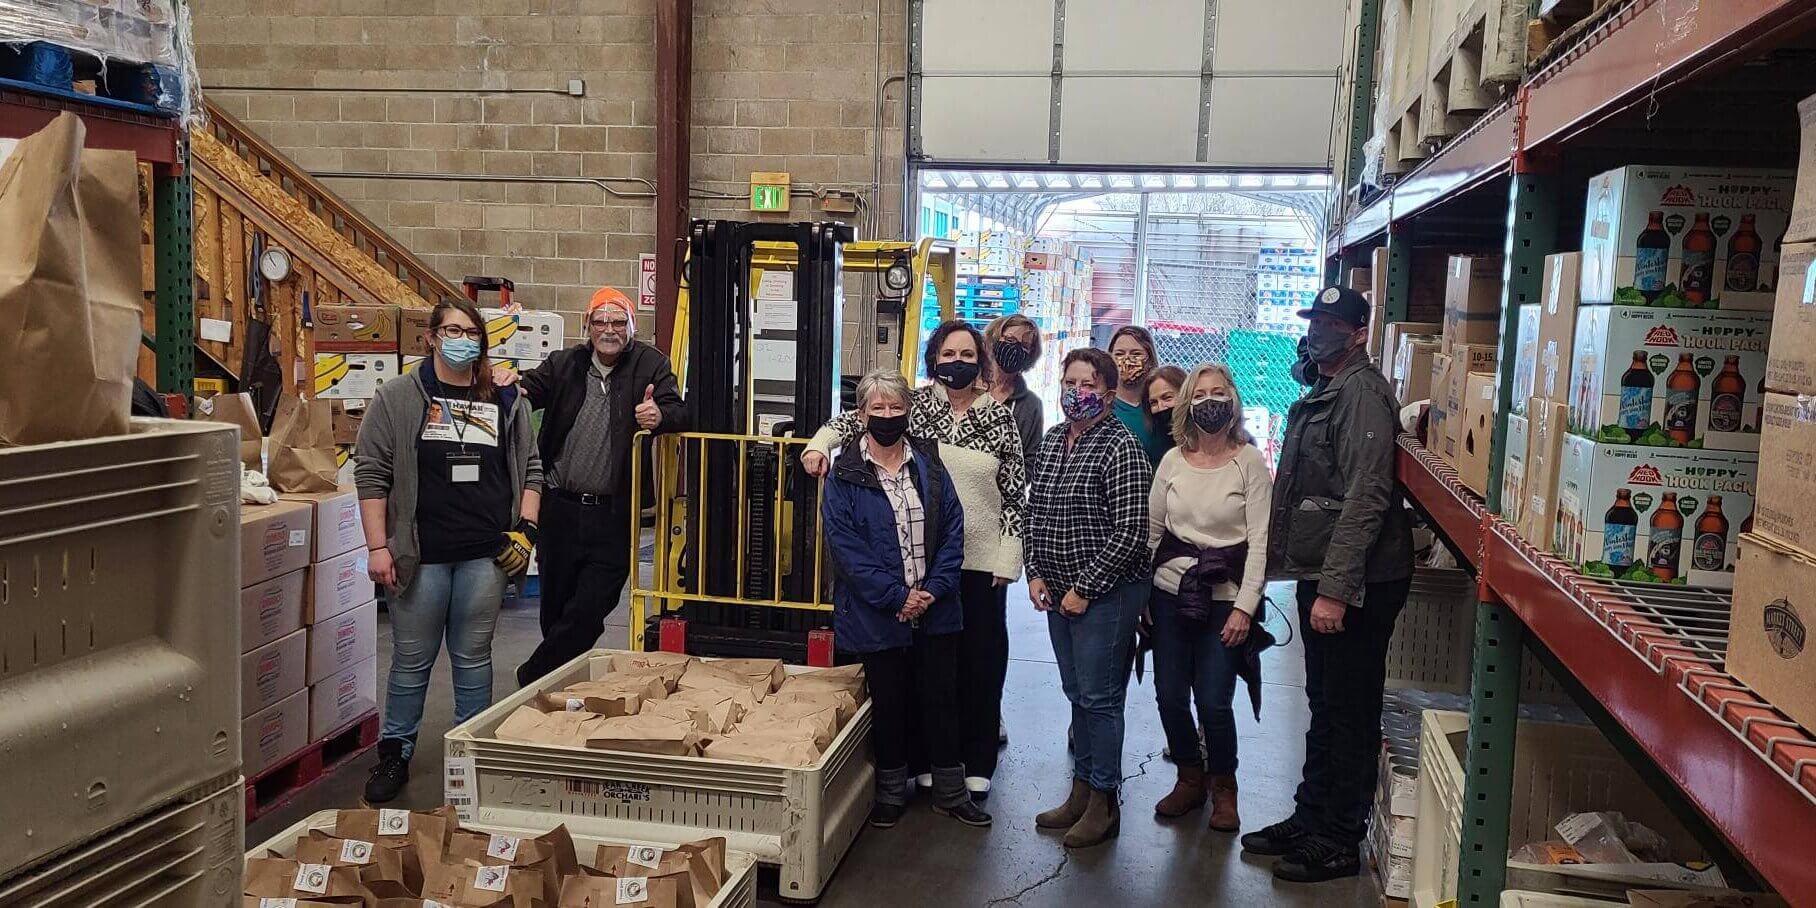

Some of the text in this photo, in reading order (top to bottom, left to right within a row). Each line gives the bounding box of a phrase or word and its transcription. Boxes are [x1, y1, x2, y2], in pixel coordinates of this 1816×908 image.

[1718, 184, 1773, 196] HOPPY
[755, 186, 784, 209] EXIT
[644, 260, 655, 271] NO
[1702, 326, 1756, 337] HOPPY
[1685, 466, 1738, 479] HOPPY
